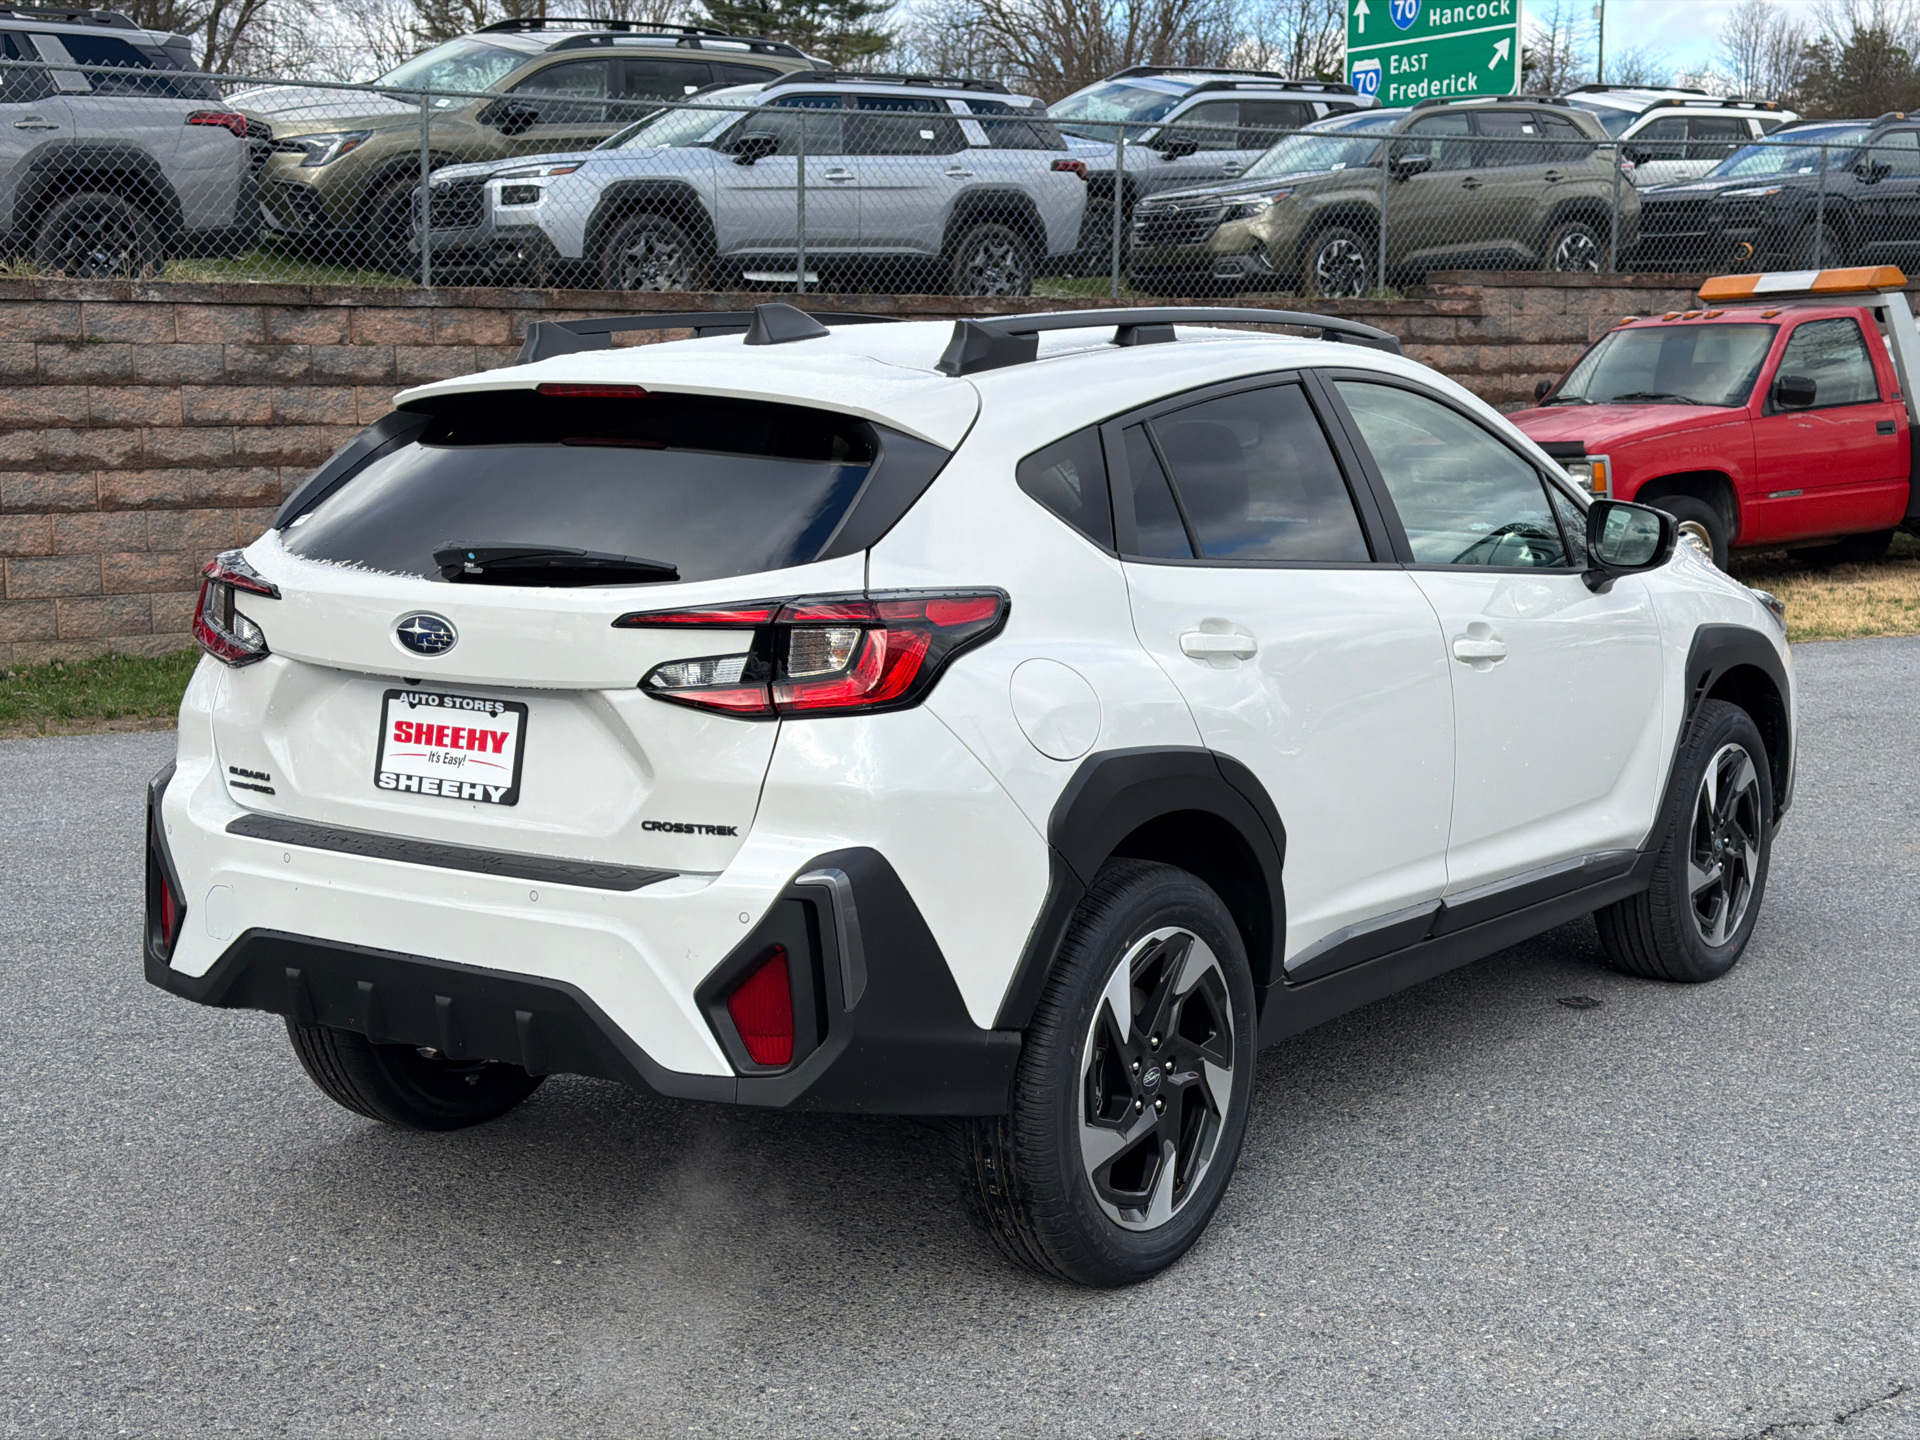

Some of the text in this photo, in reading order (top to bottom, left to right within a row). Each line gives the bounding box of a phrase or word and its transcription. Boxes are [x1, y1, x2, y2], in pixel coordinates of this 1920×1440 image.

[1394, 0, 1417, 20] 70
[1429, 0, 1510, 27] Hancock
[1390, 53, 1428, 75] EAST
[1355, 72, 1377, 94] 70
[1389, 72, 1478, 101] Frederick
[399, 692, 505, 713] AUTO STORES
[393, 720, 510, 754] SHEEHY
[428, 750, 467, 769] It's Easy!
[229, 766, 270, 782] SUBARU
[378, 772, 508, 803] SHEEHY
[641, 820, 738, 837] CROSSTREK
